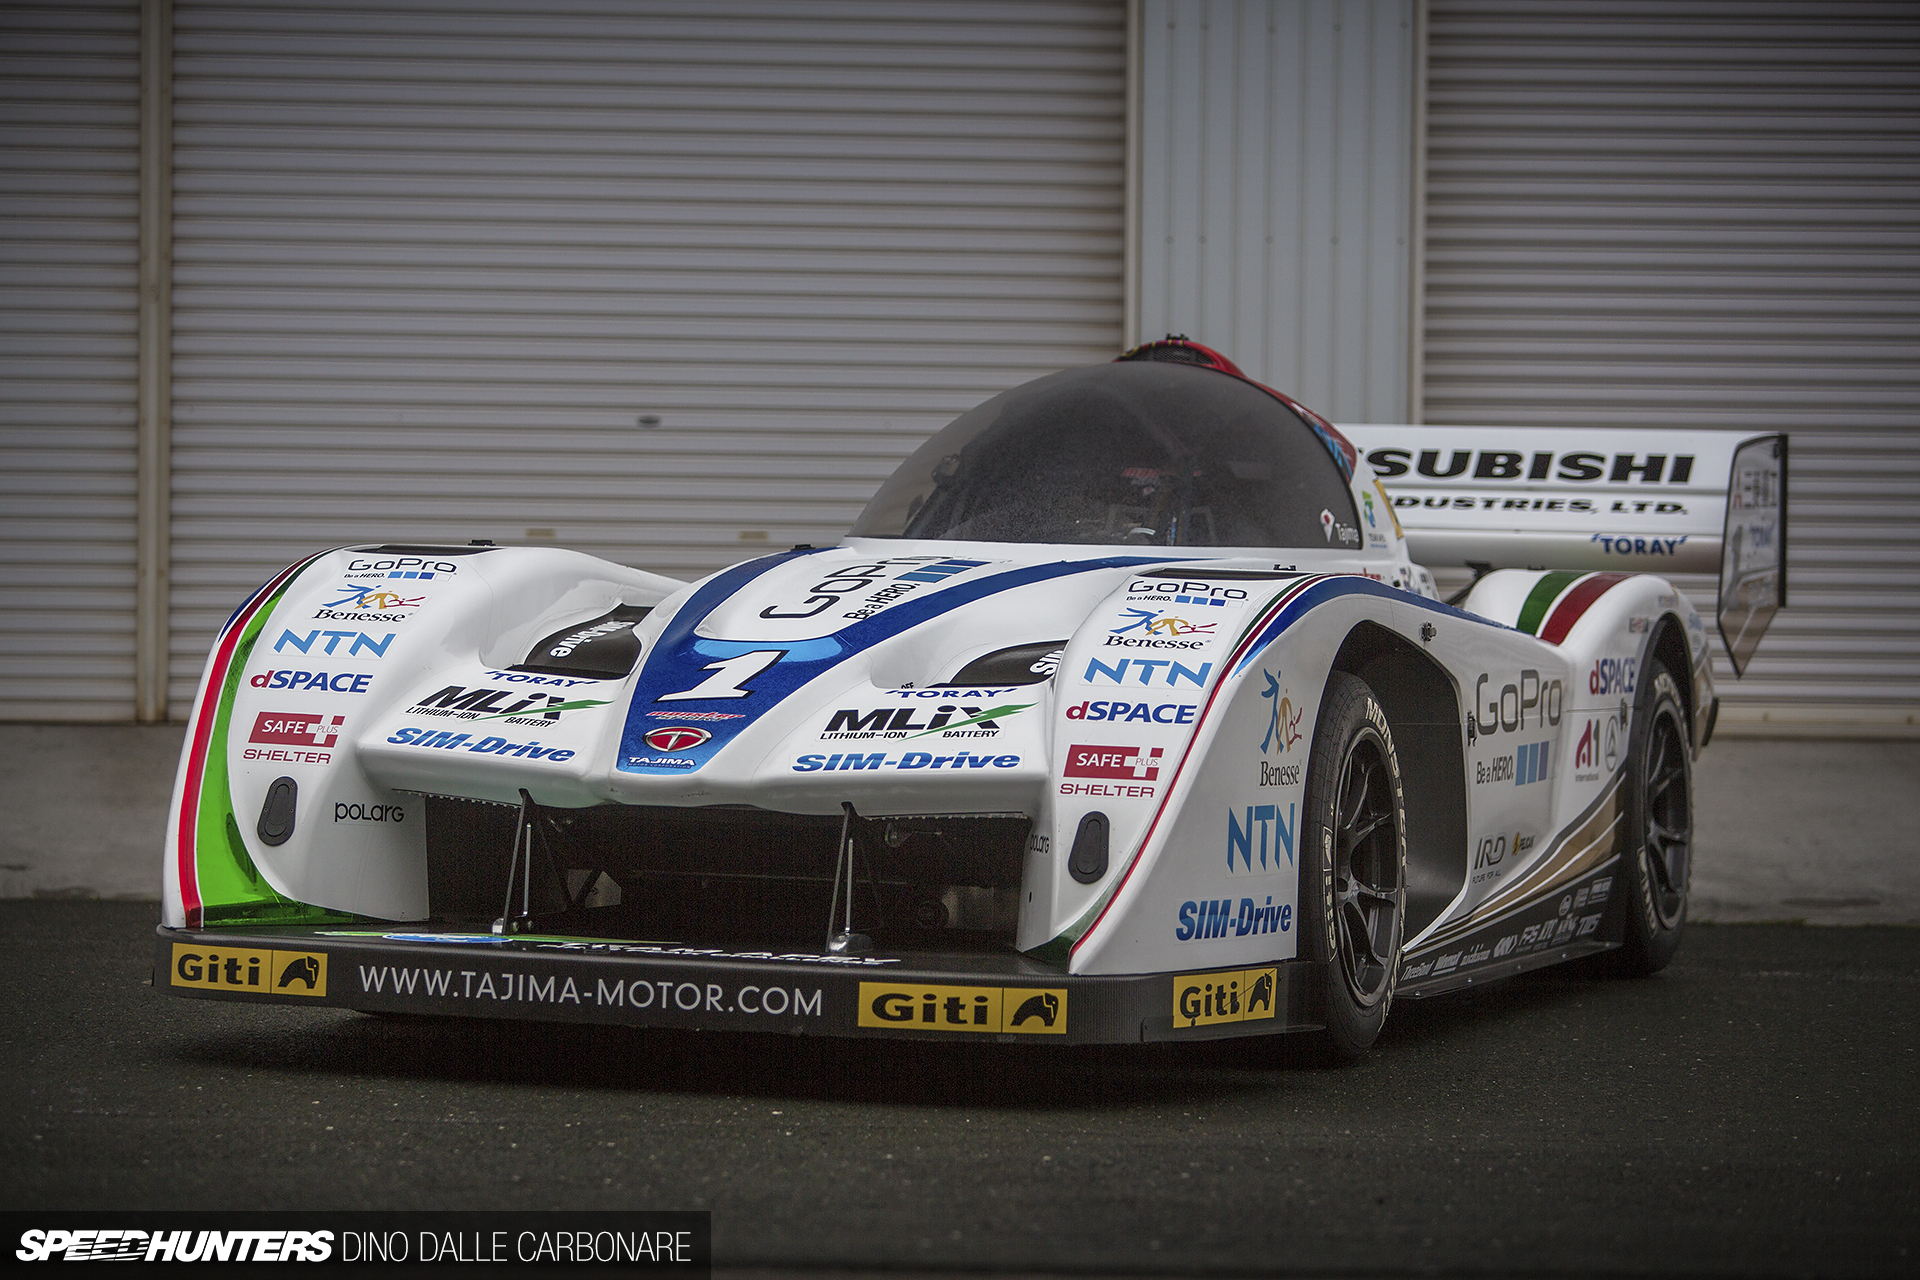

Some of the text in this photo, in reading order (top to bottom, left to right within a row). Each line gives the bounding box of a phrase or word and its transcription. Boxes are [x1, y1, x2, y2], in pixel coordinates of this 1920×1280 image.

[1358, 449, 1696, 484] SUBISHI
[1388, 497, 1688, 515] DUSTRIES, LTD.
[348, 558, 457, 573] GoPro
[842, 608, 876, 620] Be
[865, 583, 921, 604] HERO.
[1128, 580, 1248, 600] GoPro
[312, 608, 406, 623] Benesse
[273, 628, 397, 659] NTN
[1102, 635, 1204, 650] Benesse
[250, 669, 374, 694] dSPACE
[651, 649, 790, 704] 1
[1083, 656, 1214, 689] NTN
[1589, 657, 1636, 695] dSPACE
[1065, 701, 1197, 724] dSPACE
[1476, 669, 1563, 736] GoPro
[262, 719, 339, 735] SAFE PLUS
[405, 706, 557, 729] LITHIUM-ION BATTERY
[386, 727, 576, 762] SIM-Drive
[820, 730, 1000, 740] LITHIUM-ION BATTERY
[243, 748, 332, 764] SHELTER
[628, 756, 696, 766] TAJIMA
[791, 751, 1021, 772] SIM-Drive
[1076, 752, 1159, 768] SAFE PLUS
[1259, 760, 1300, 787] Benesse
[1476, 755, 1514, 785] Be a HERO.
[1060, 783, 1155, 798] SHELTER
[1227, 803, 1295, 875] NTN
[1176, 896, 1292, 941] SIM-Drive
[177, 953, 262, 986] Giti
[359, 965, 822, 1016] WWW.TAJIMA-MOTOR.COM
[1179, 980, 1240, 1019] Giti
[871, 992, 989, 1025] Giti
